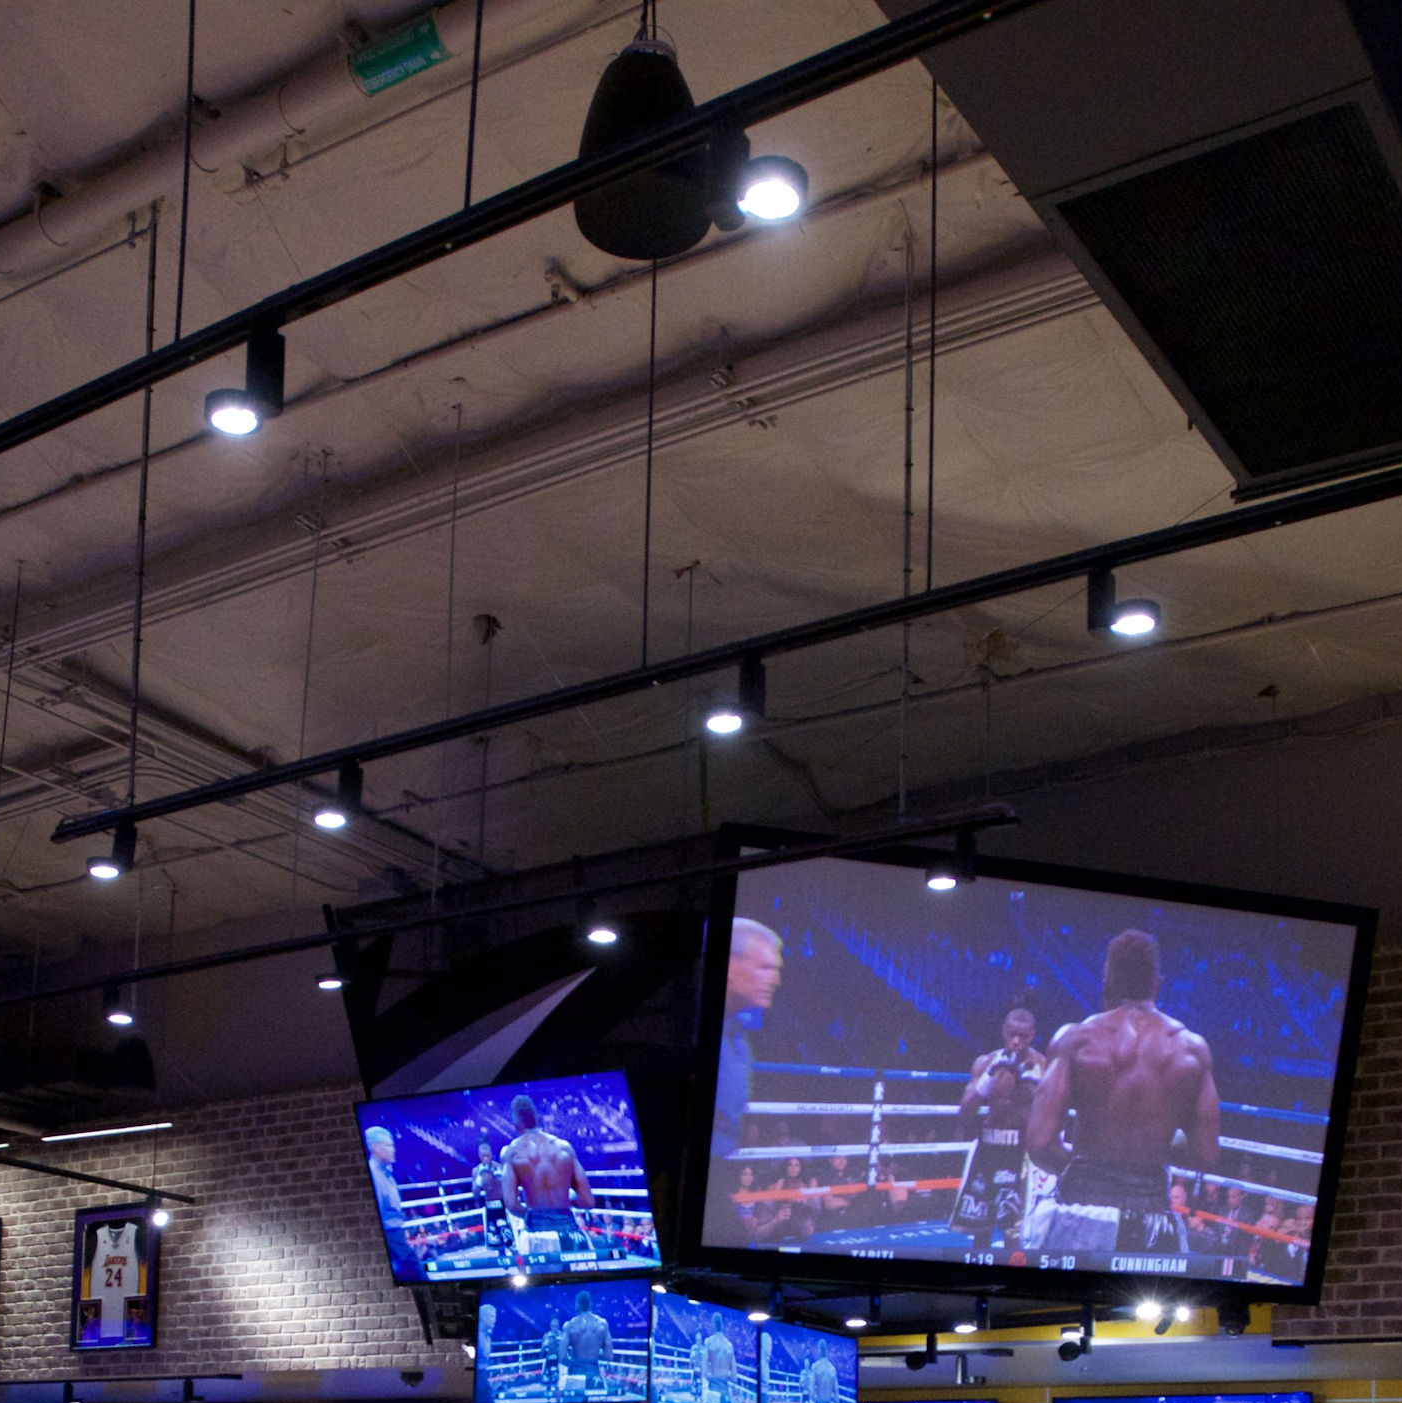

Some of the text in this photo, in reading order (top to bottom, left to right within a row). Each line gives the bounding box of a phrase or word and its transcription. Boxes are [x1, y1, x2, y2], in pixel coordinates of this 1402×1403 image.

[1040, 1255, 1049, 1270] 5
[1061, 1256, 1076, 1271] 10
[1111, 1256, 1188, 1272] CUNNINGHAM
[105, 1268, 122, 1287] 24
